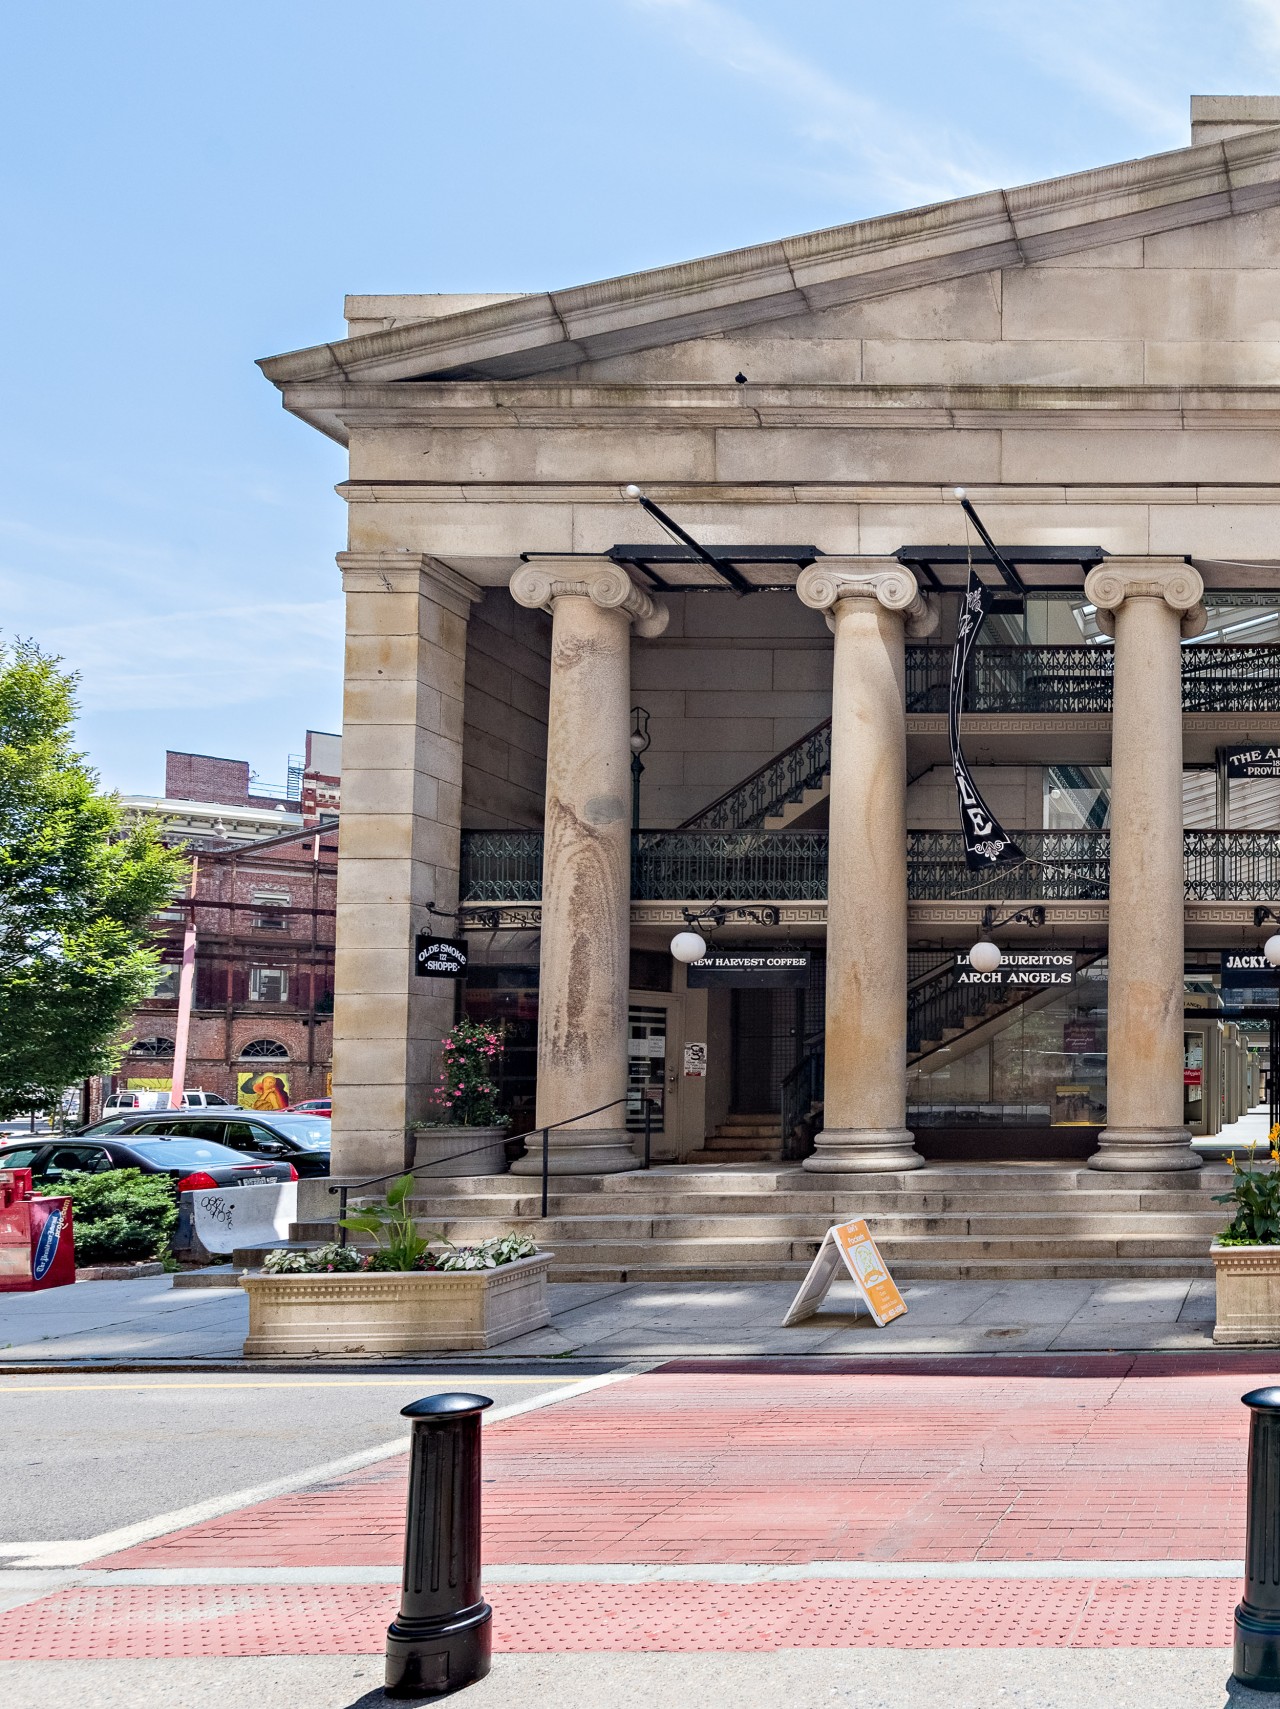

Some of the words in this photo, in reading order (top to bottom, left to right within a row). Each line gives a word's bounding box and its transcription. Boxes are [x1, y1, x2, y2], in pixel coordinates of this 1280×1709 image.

[1229, 750, 1262, 766] THE
[418, 943, 440, 962] OLDE
[440, 943, 467, 965] SMOKE
[427, 960, 458, 972] SHOPPE
[715, 958, 765, 966] HARVEST
[766, 958, 807, 966] COFFEE
[999, 955, 1073, 966] BURRITOS
[957, 972, 1002, 983] ARCH
[1007, 972, 1072, 983] ANGELS
[54, 1199, 70, 1238] projo.com
